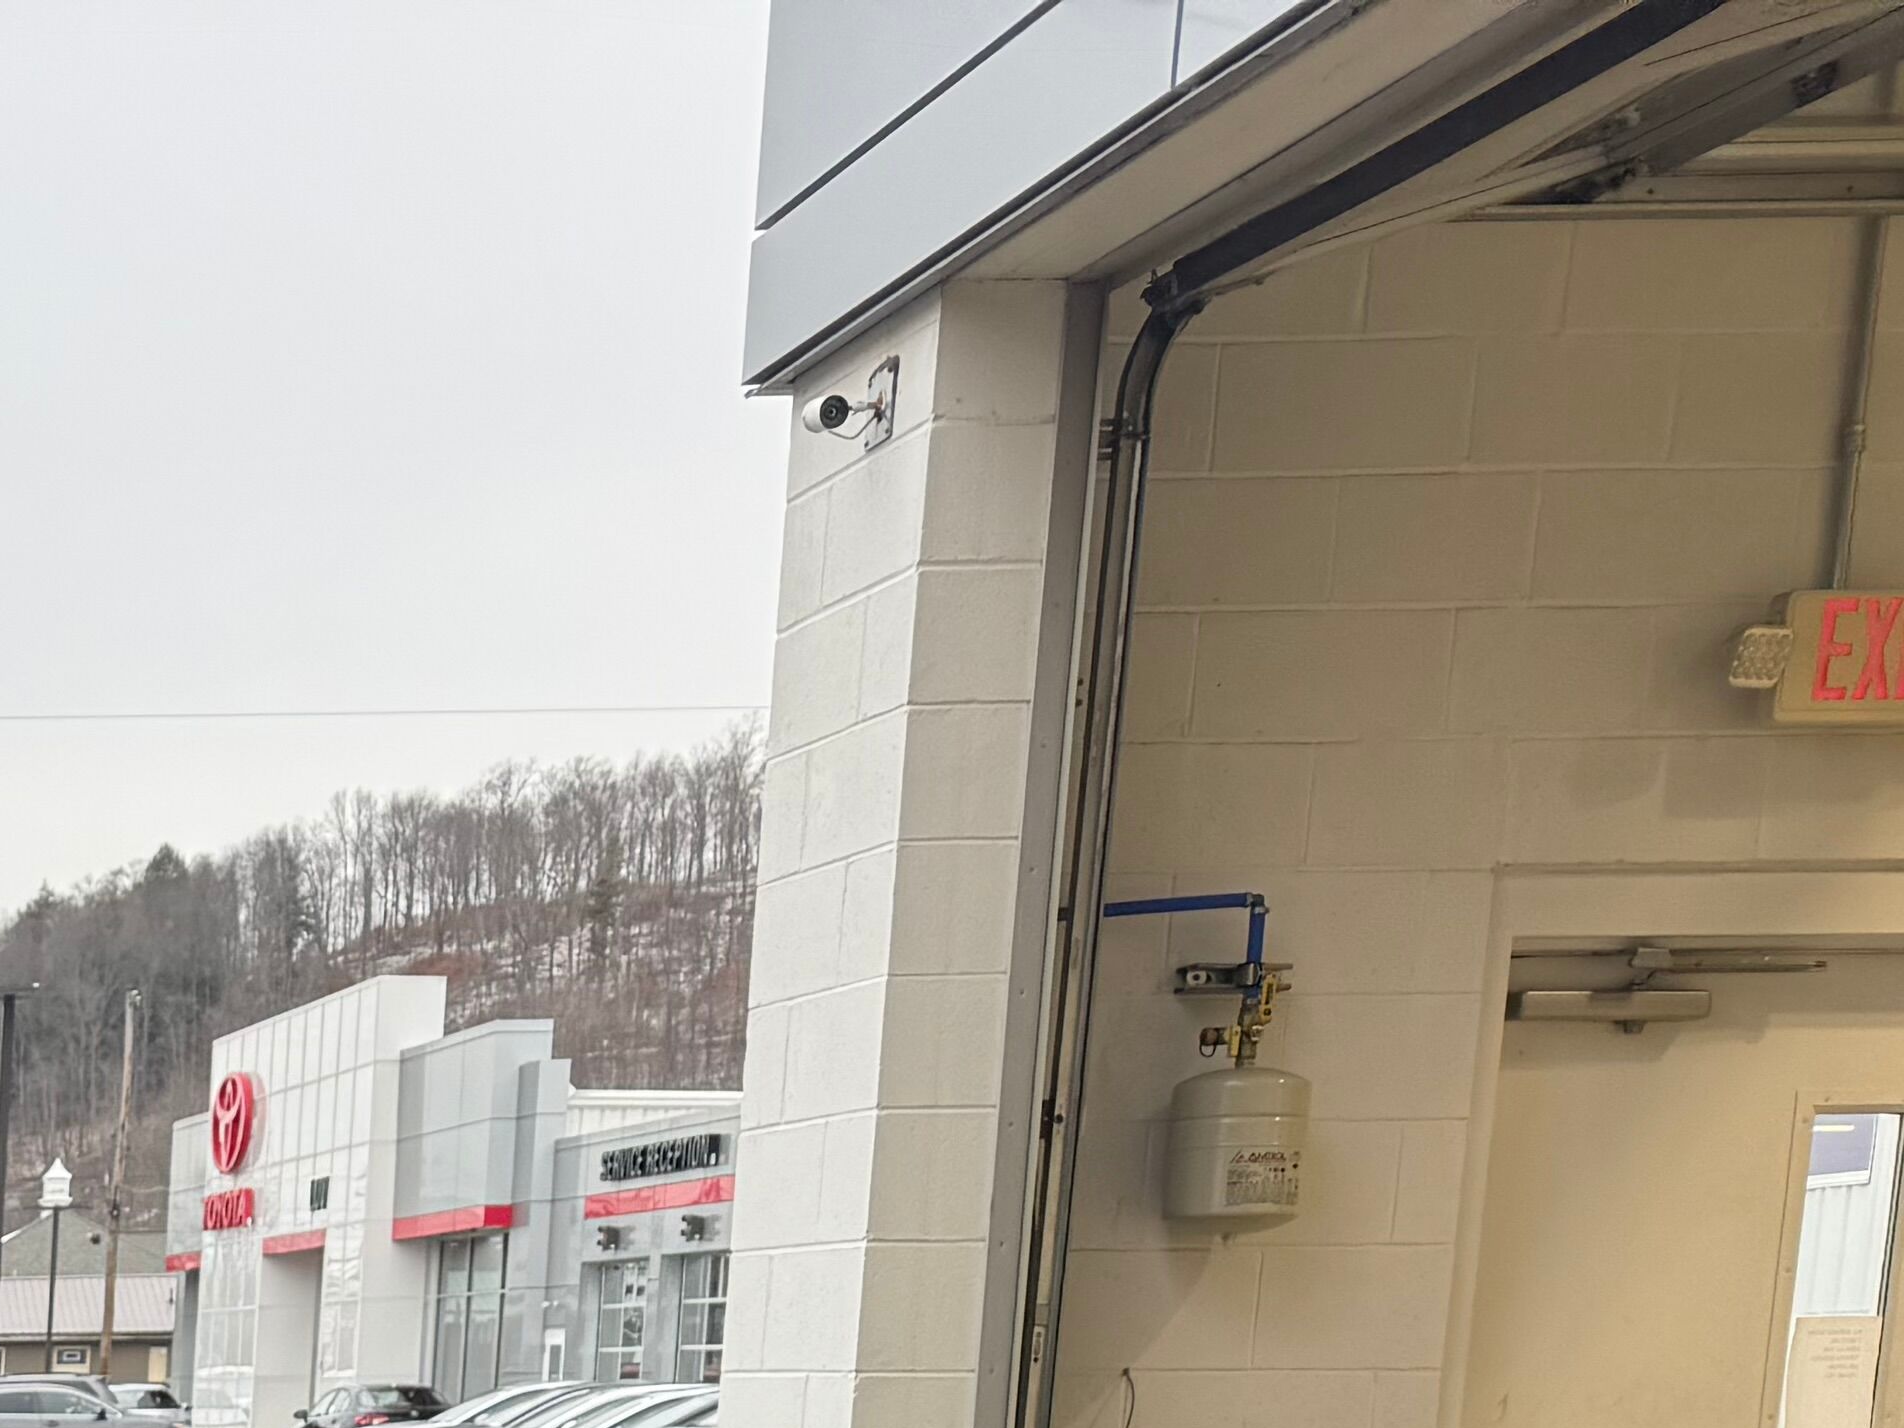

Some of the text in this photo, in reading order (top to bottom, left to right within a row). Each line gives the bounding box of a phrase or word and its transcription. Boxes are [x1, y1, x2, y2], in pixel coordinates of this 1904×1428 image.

[1811, 597, 1904, 701] EX
[600, 1133, 720, 1181] SERVICE RECEPTION
[201, 1188, 254, 1230] TOYOTA
